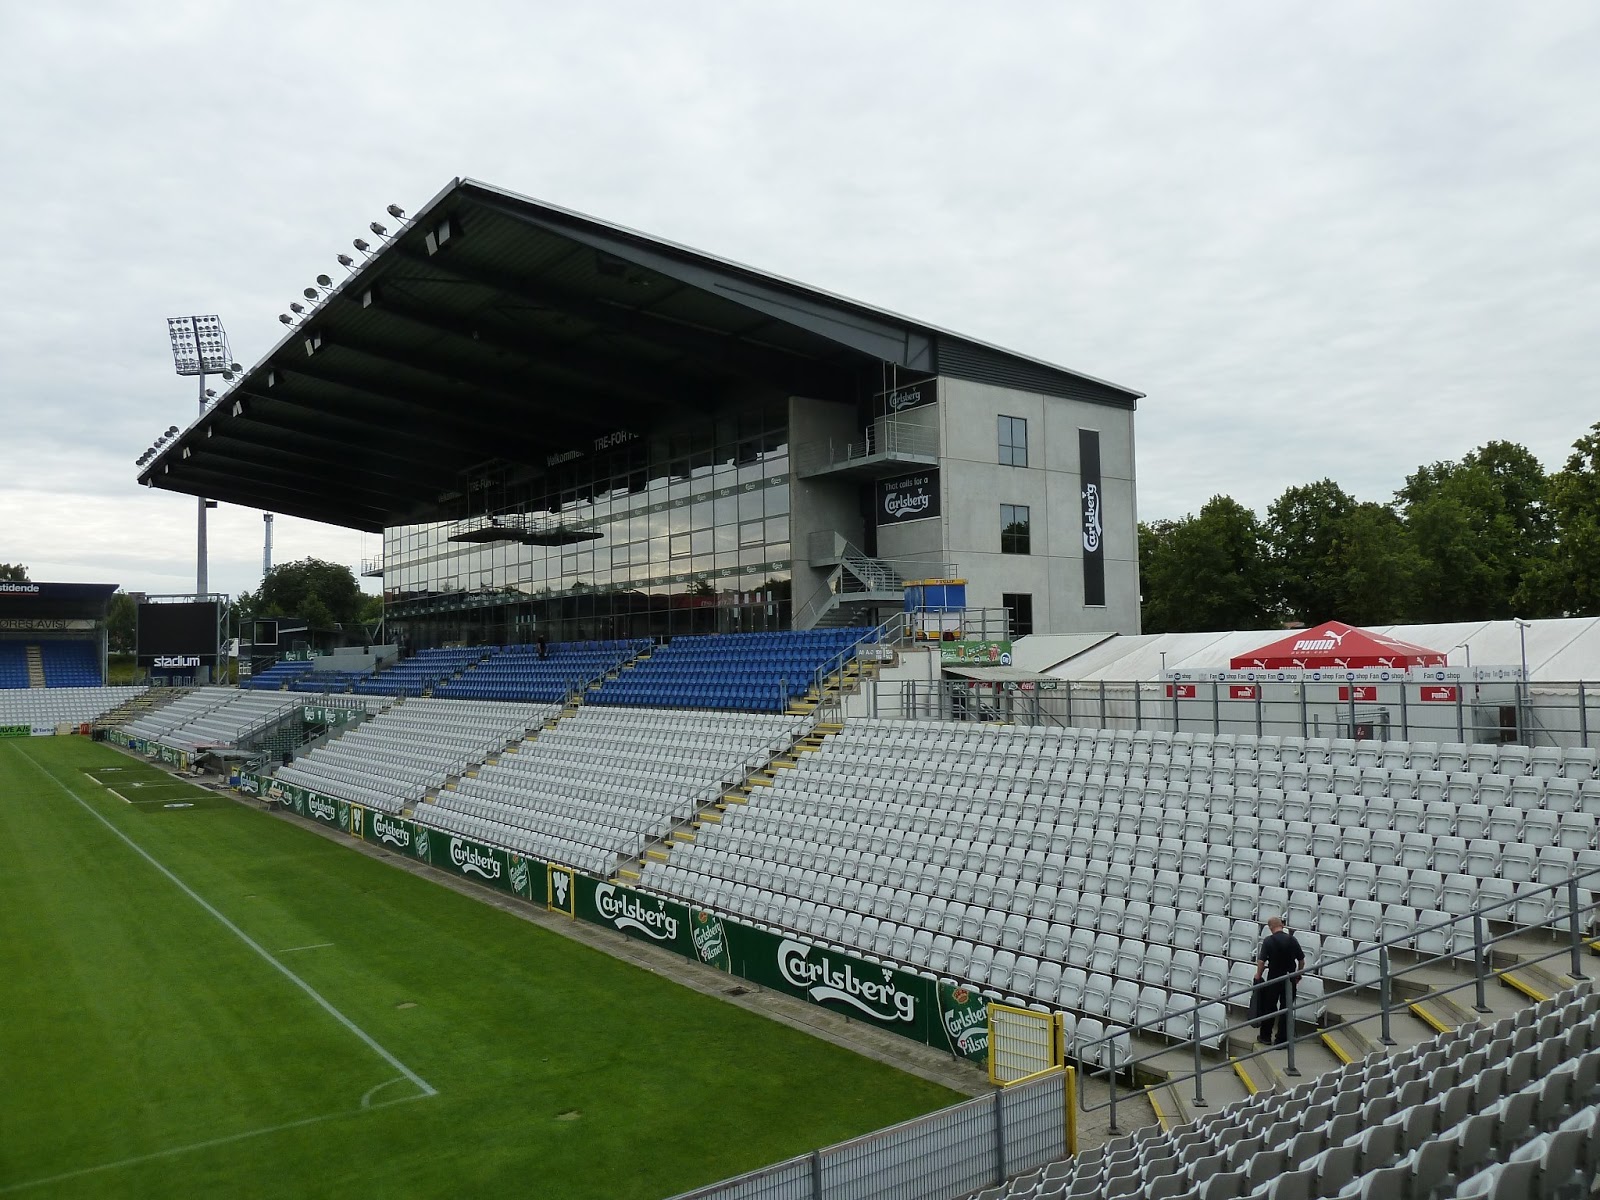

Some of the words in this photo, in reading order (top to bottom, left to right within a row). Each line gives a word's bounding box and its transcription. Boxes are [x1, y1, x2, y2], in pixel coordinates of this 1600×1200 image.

[889, 391, 921, 410] Carlsberg
[885, 482, 898, 491] That
[900, 480, 913, 489] calls
[914, 478, 922, 486] for
[885, 492, 929, 518] Carlsberg
[1083, 484, 1102, 552] Carlsberg
[1293, 640, 1335, 651] PUMA
[154, 655, 200, 667] stadium
[1447, 672, 1460, 680] shop
[309, 793, 335, 820] Carlsberg
[374, 813, 410, 847] Carlsberg
[450, 837, 501, 879] Carlsberg
[594, 882, 679, 941] Carlsberg
[694, 922, 722, 949] Carlsberg
[777, 938, 915, 1022] Carlsberg
[945, 1006, 988, 1039] Carlsber
[959, 1035, 988, 1055] Pilsn
